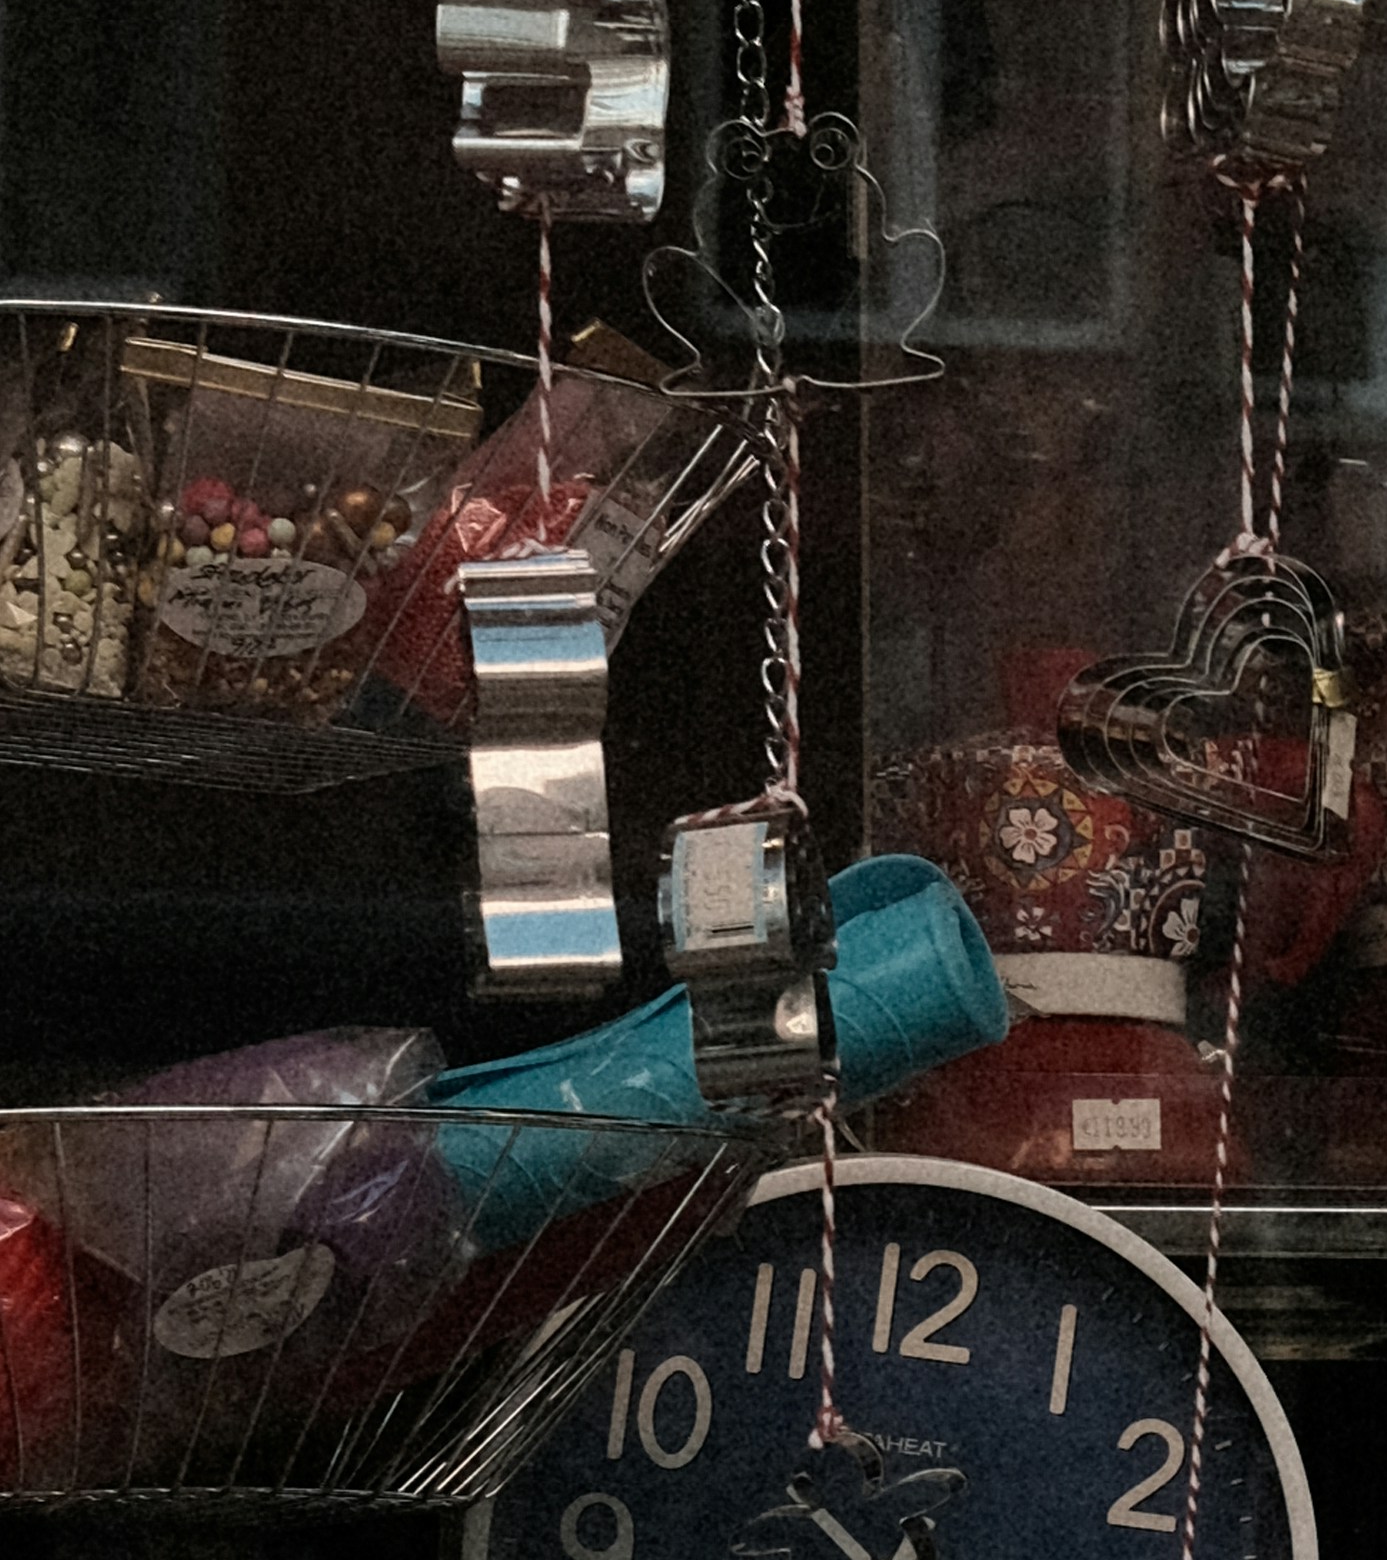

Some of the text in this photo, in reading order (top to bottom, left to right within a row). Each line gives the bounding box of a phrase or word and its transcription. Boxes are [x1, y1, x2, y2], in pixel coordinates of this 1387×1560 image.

[745, 1263, 818, 1379] 11
[872, 1243, 980, 1365] 12
[1049, 1304, 1078, 1414] 1
[608, 1348, 712, 1469] 10
[1106, 1418, 1185, 1532] 2
